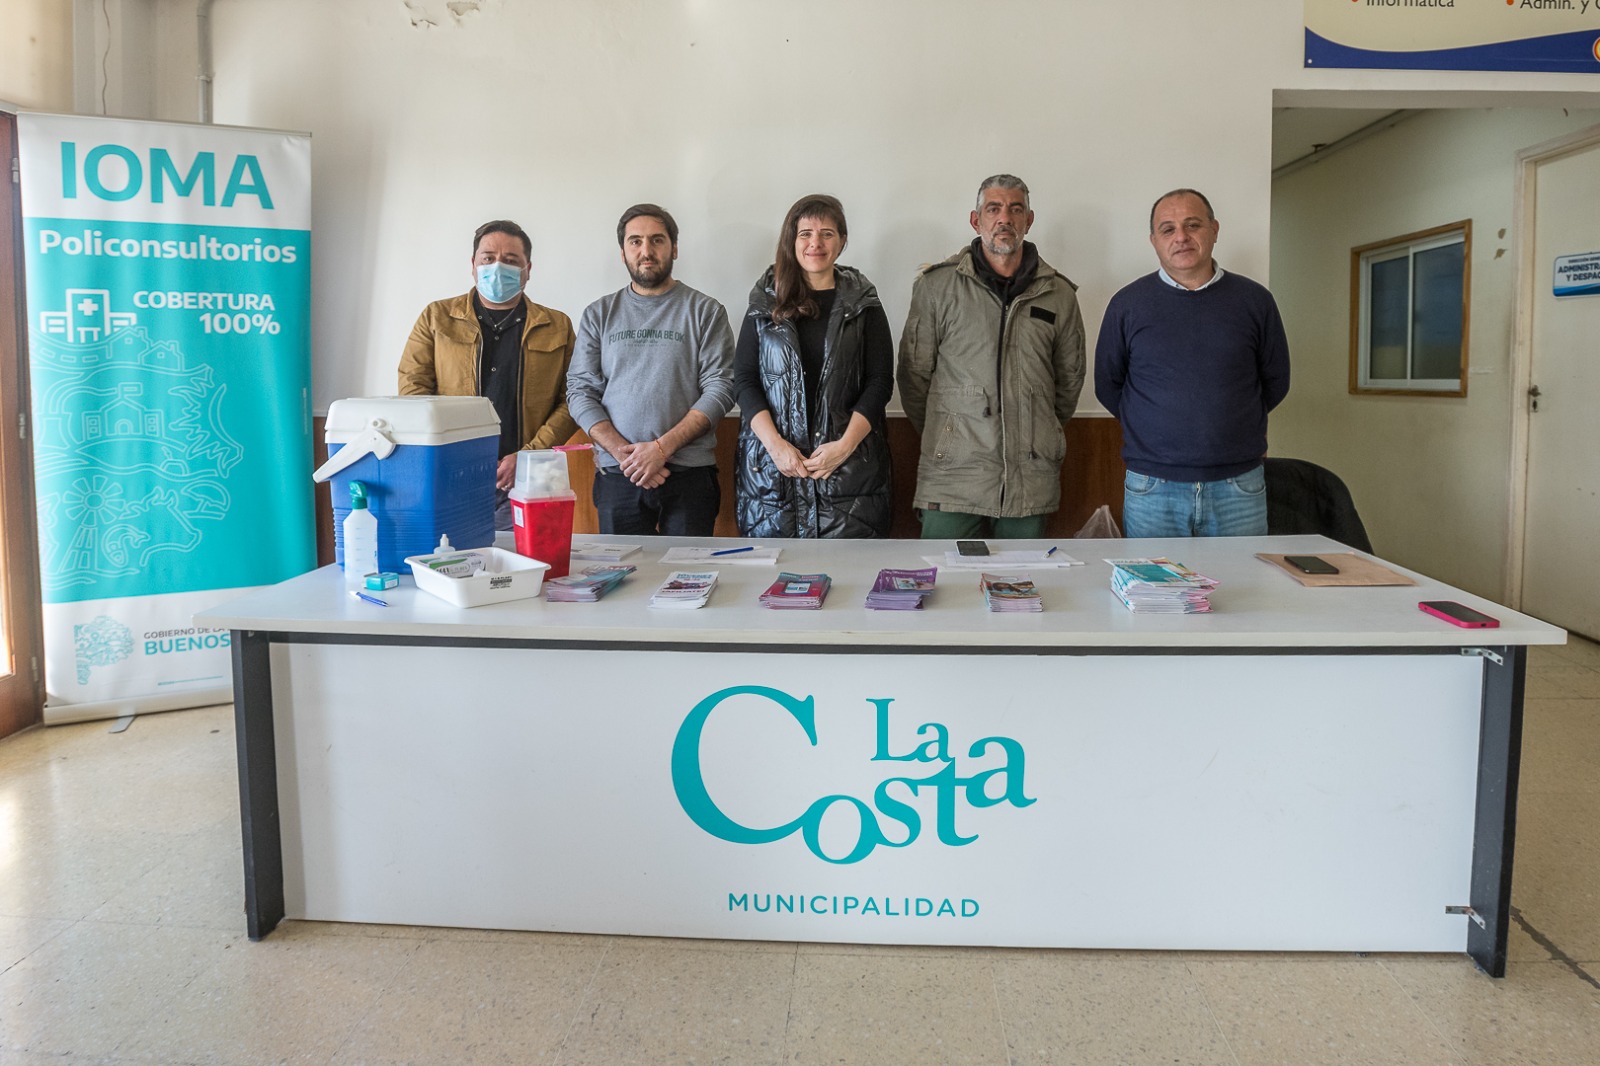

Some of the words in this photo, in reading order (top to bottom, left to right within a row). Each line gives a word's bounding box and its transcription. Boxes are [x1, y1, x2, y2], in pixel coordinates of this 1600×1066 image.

[1580, 0, 1590, 15] y
[61, 142, 274, 210] IOMA
[39, 230, 297, 263] Policonsultorios
[1558, 263, 1600, 273] ADMINISTR
[133, 291, 275, 311] COBERTURA
[199, 313, 281, 335] 100%
[608, 329, 636, 345] FUTURE
[637, 328, 663, 339] GONNA
[664, 330, 674, 340] BE
[144, 628, 195, 639] GOBIERNO
[144, 633, 231, 655] BUENOS
[866, 697, 954, 763] La
[671, 685, 1037, 865] Costa
[729, 893, 980, 918] MUNICIPALIDAD
